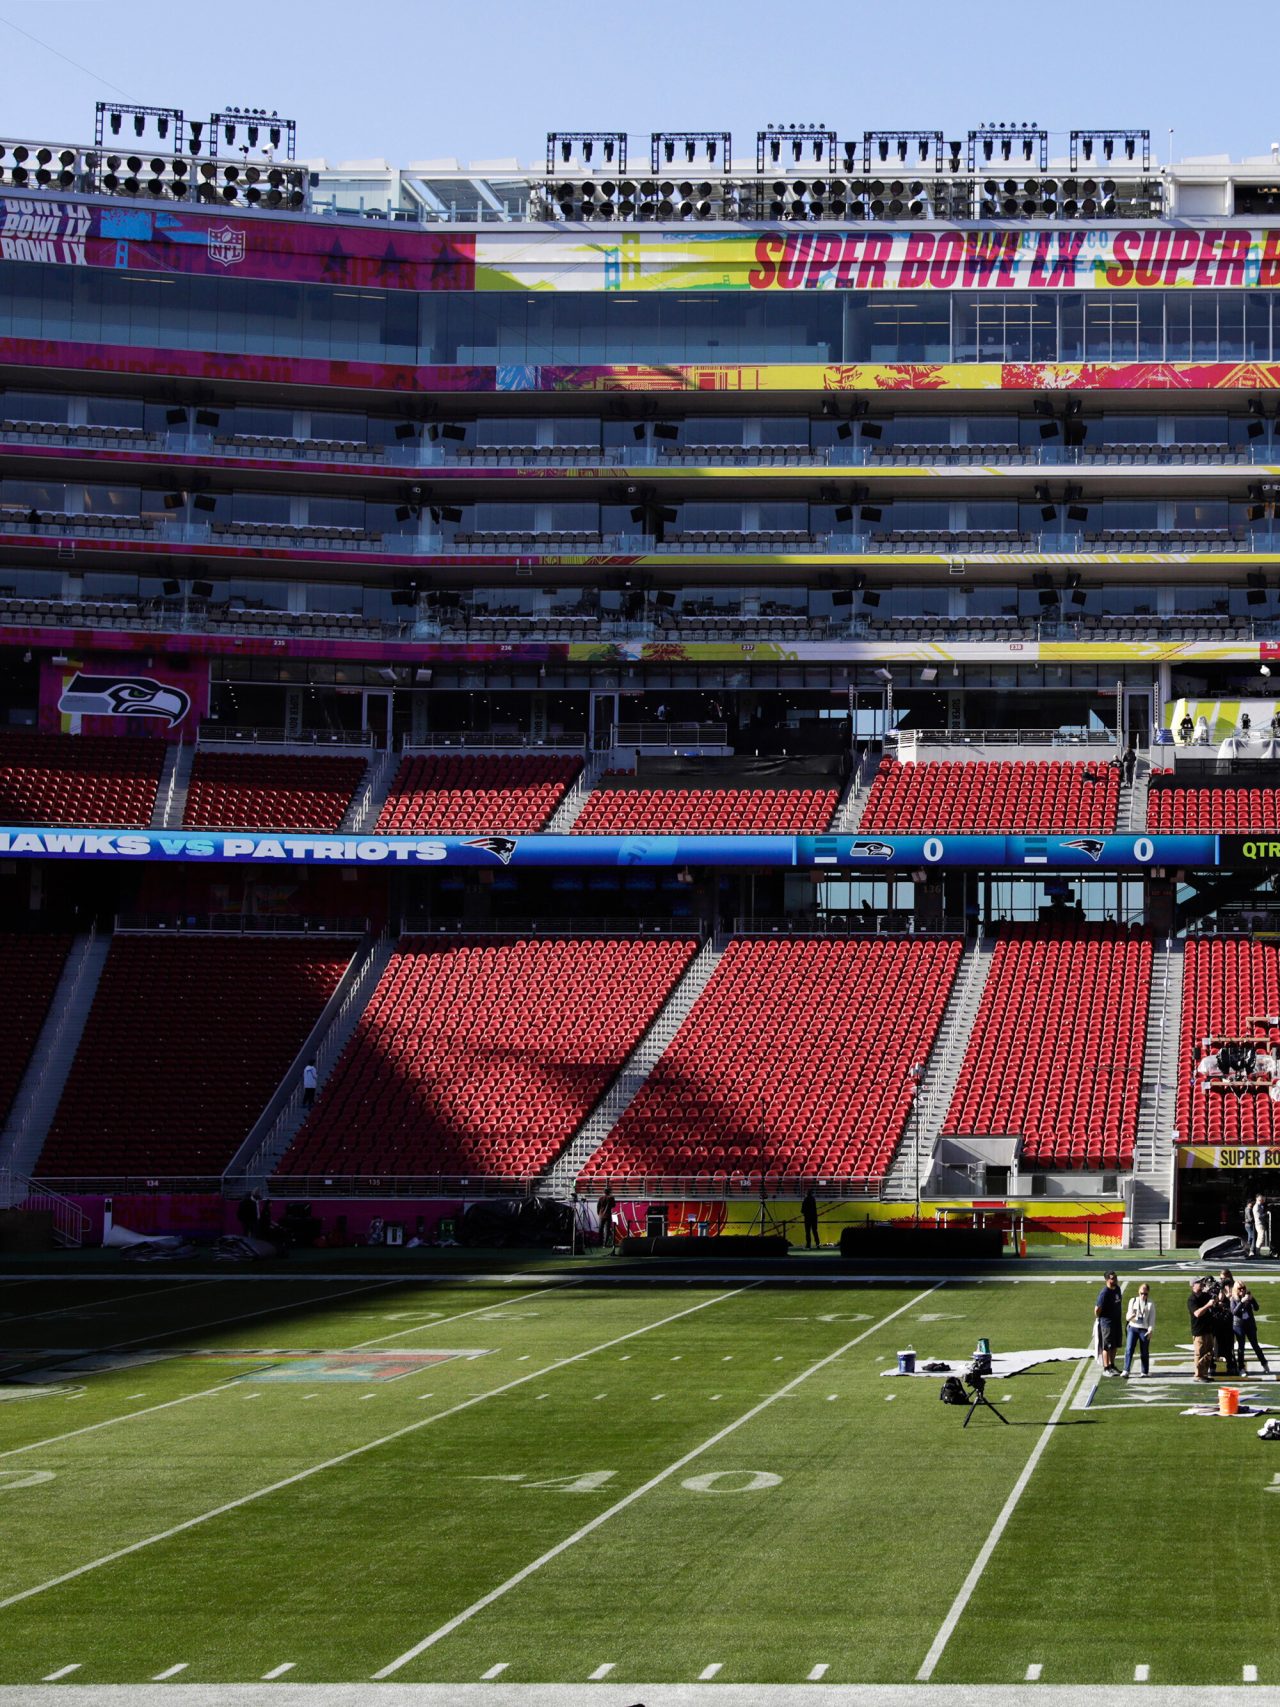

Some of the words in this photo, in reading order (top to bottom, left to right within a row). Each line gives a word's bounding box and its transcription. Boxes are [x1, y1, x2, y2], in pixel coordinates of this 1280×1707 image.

[2, 213, 61, 239] BOWL
[63, 219, 92, 242] LX
[211, 243, 242, 260] NFL
[748, 231, 894, 289] SUPER
[899, 231, 1021, 288] BOWL
[1027, 231, 1087, 288] LX
[1105, 230, 1252, 287] SUPER
[951, 698, 961, 719] SUPER
[0, 834, 151, 857] AWKS
[159, 839, 215, 856] VS
[222, 838, 447, 861] PATRIOTS
[923, 838, 944, 862] 0
[1133, 838, 1154, 862] 0
[1220, 1149, 1261, 1166] SUPER
[146, 1179, 160, 1188] 134
[368, 1179, 381, 1187] 135
[740, 1179, 752, 1187] 136
